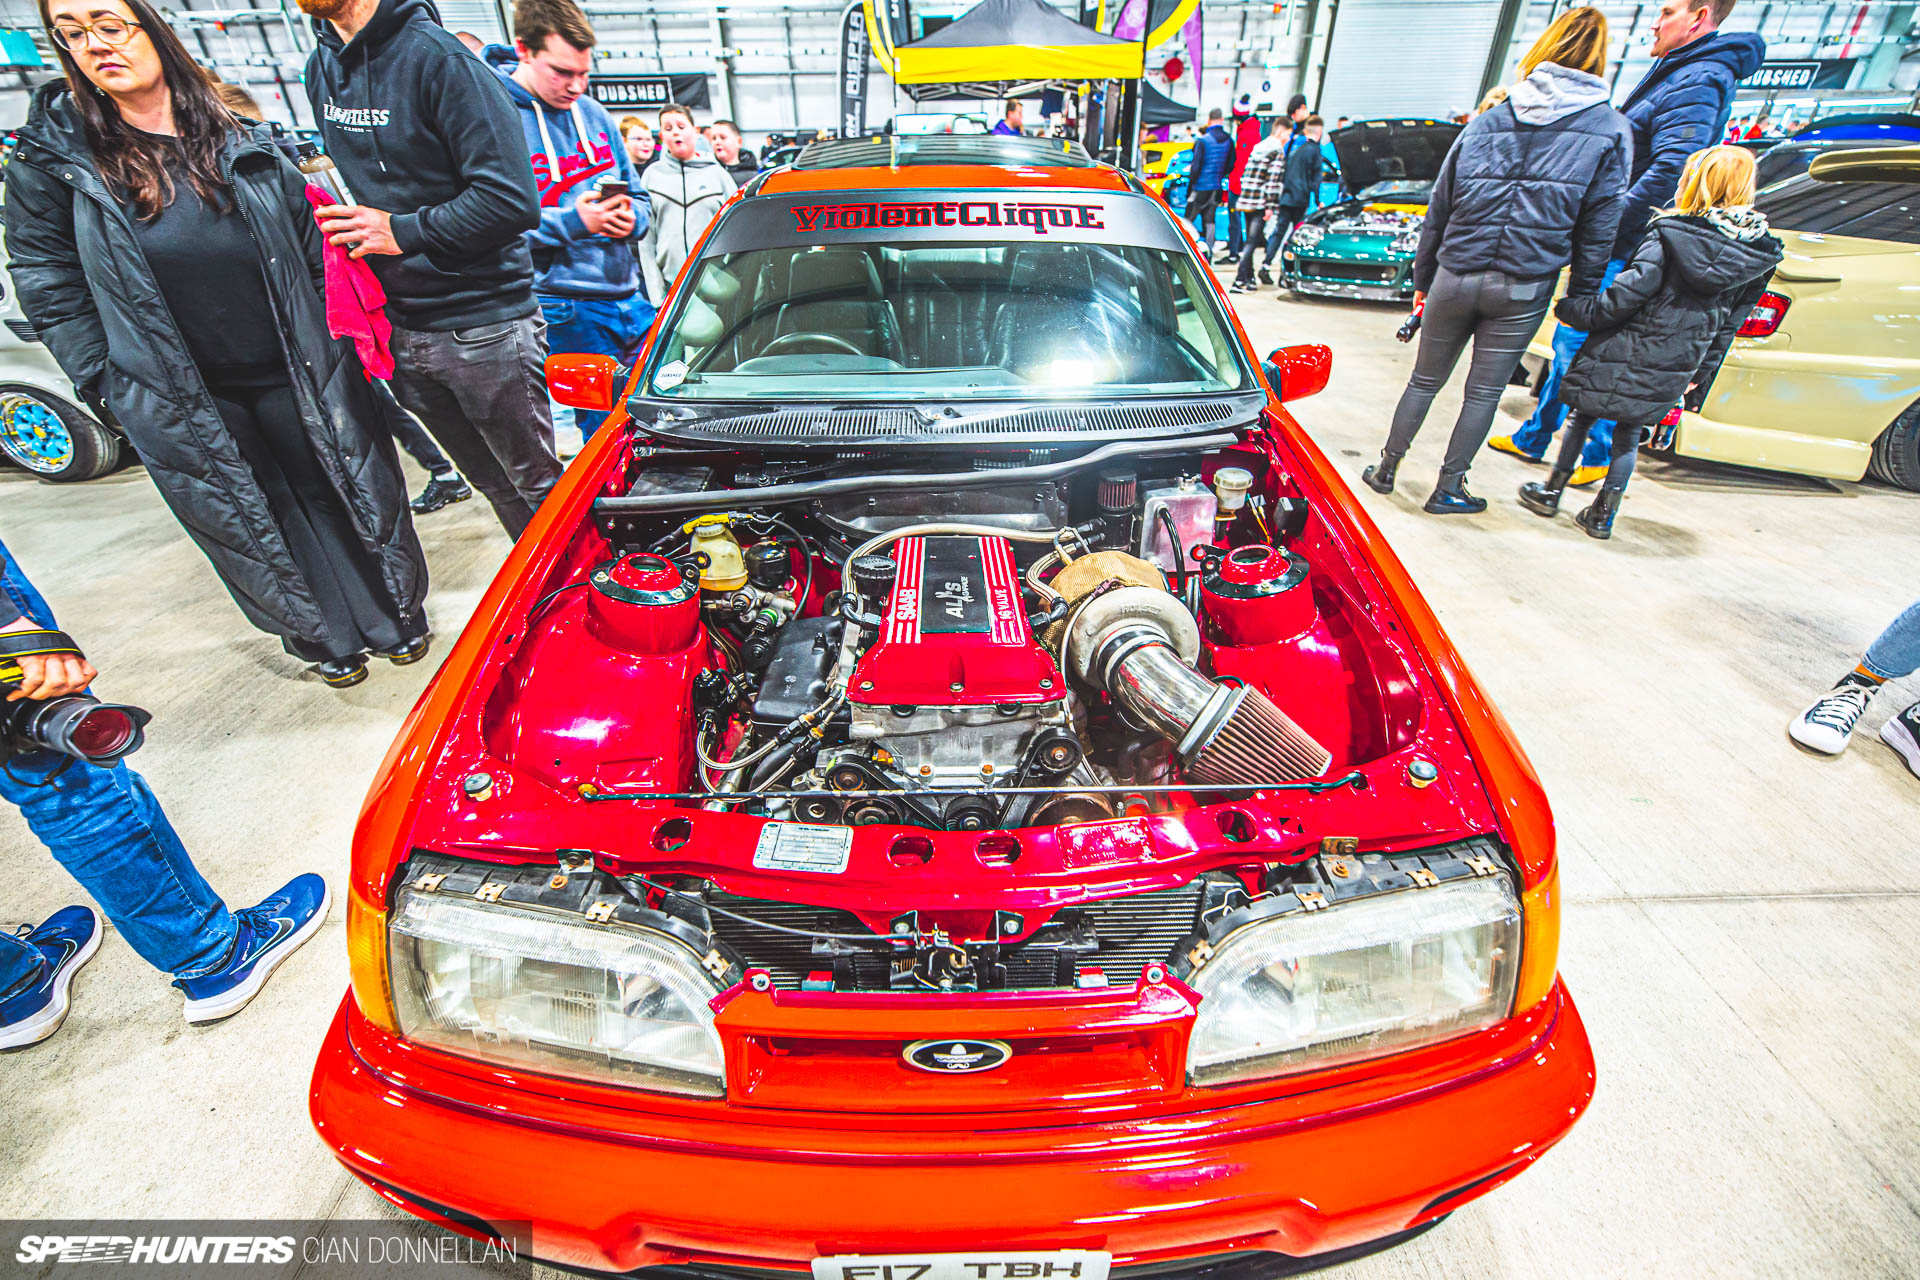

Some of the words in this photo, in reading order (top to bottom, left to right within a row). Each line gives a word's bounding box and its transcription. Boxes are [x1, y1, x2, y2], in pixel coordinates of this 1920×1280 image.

[597, 84, 666, 102] DUBSHED
[896, 588, 917, 620] SAAB
[994, 589, 1009, 610] VALVE
[963, 1261, 1082, 1279] TBH
